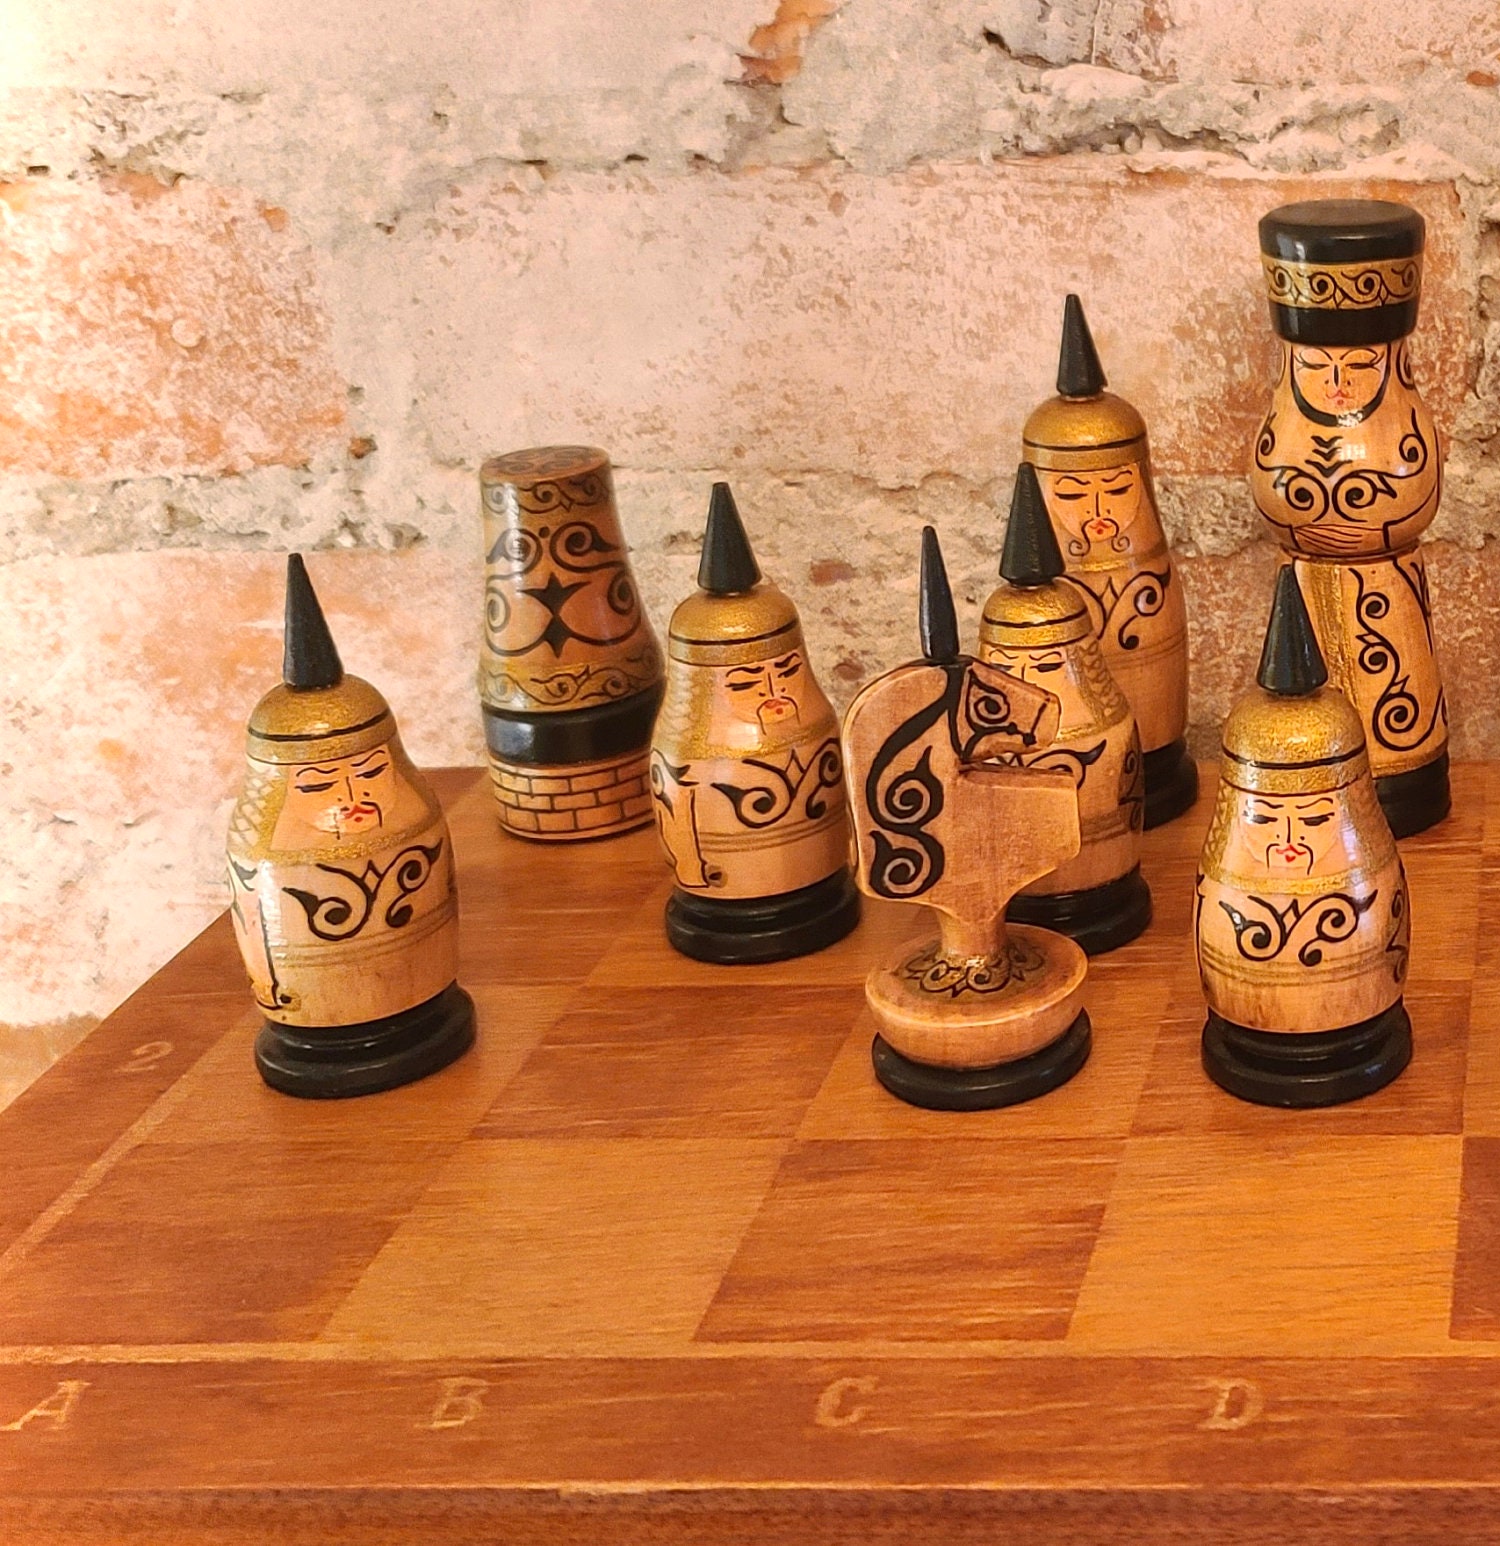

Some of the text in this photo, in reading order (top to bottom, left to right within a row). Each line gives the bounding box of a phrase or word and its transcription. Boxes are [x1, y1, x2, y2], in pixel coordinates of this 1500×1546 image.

[114, 1040, 174, 1072] 2
[0, 1379, 93, 1431] A
[412, 1377, 488, 1430] B
[815, 1376, 880, 1428] C
[1198, 1377, 1263, 1430] D
